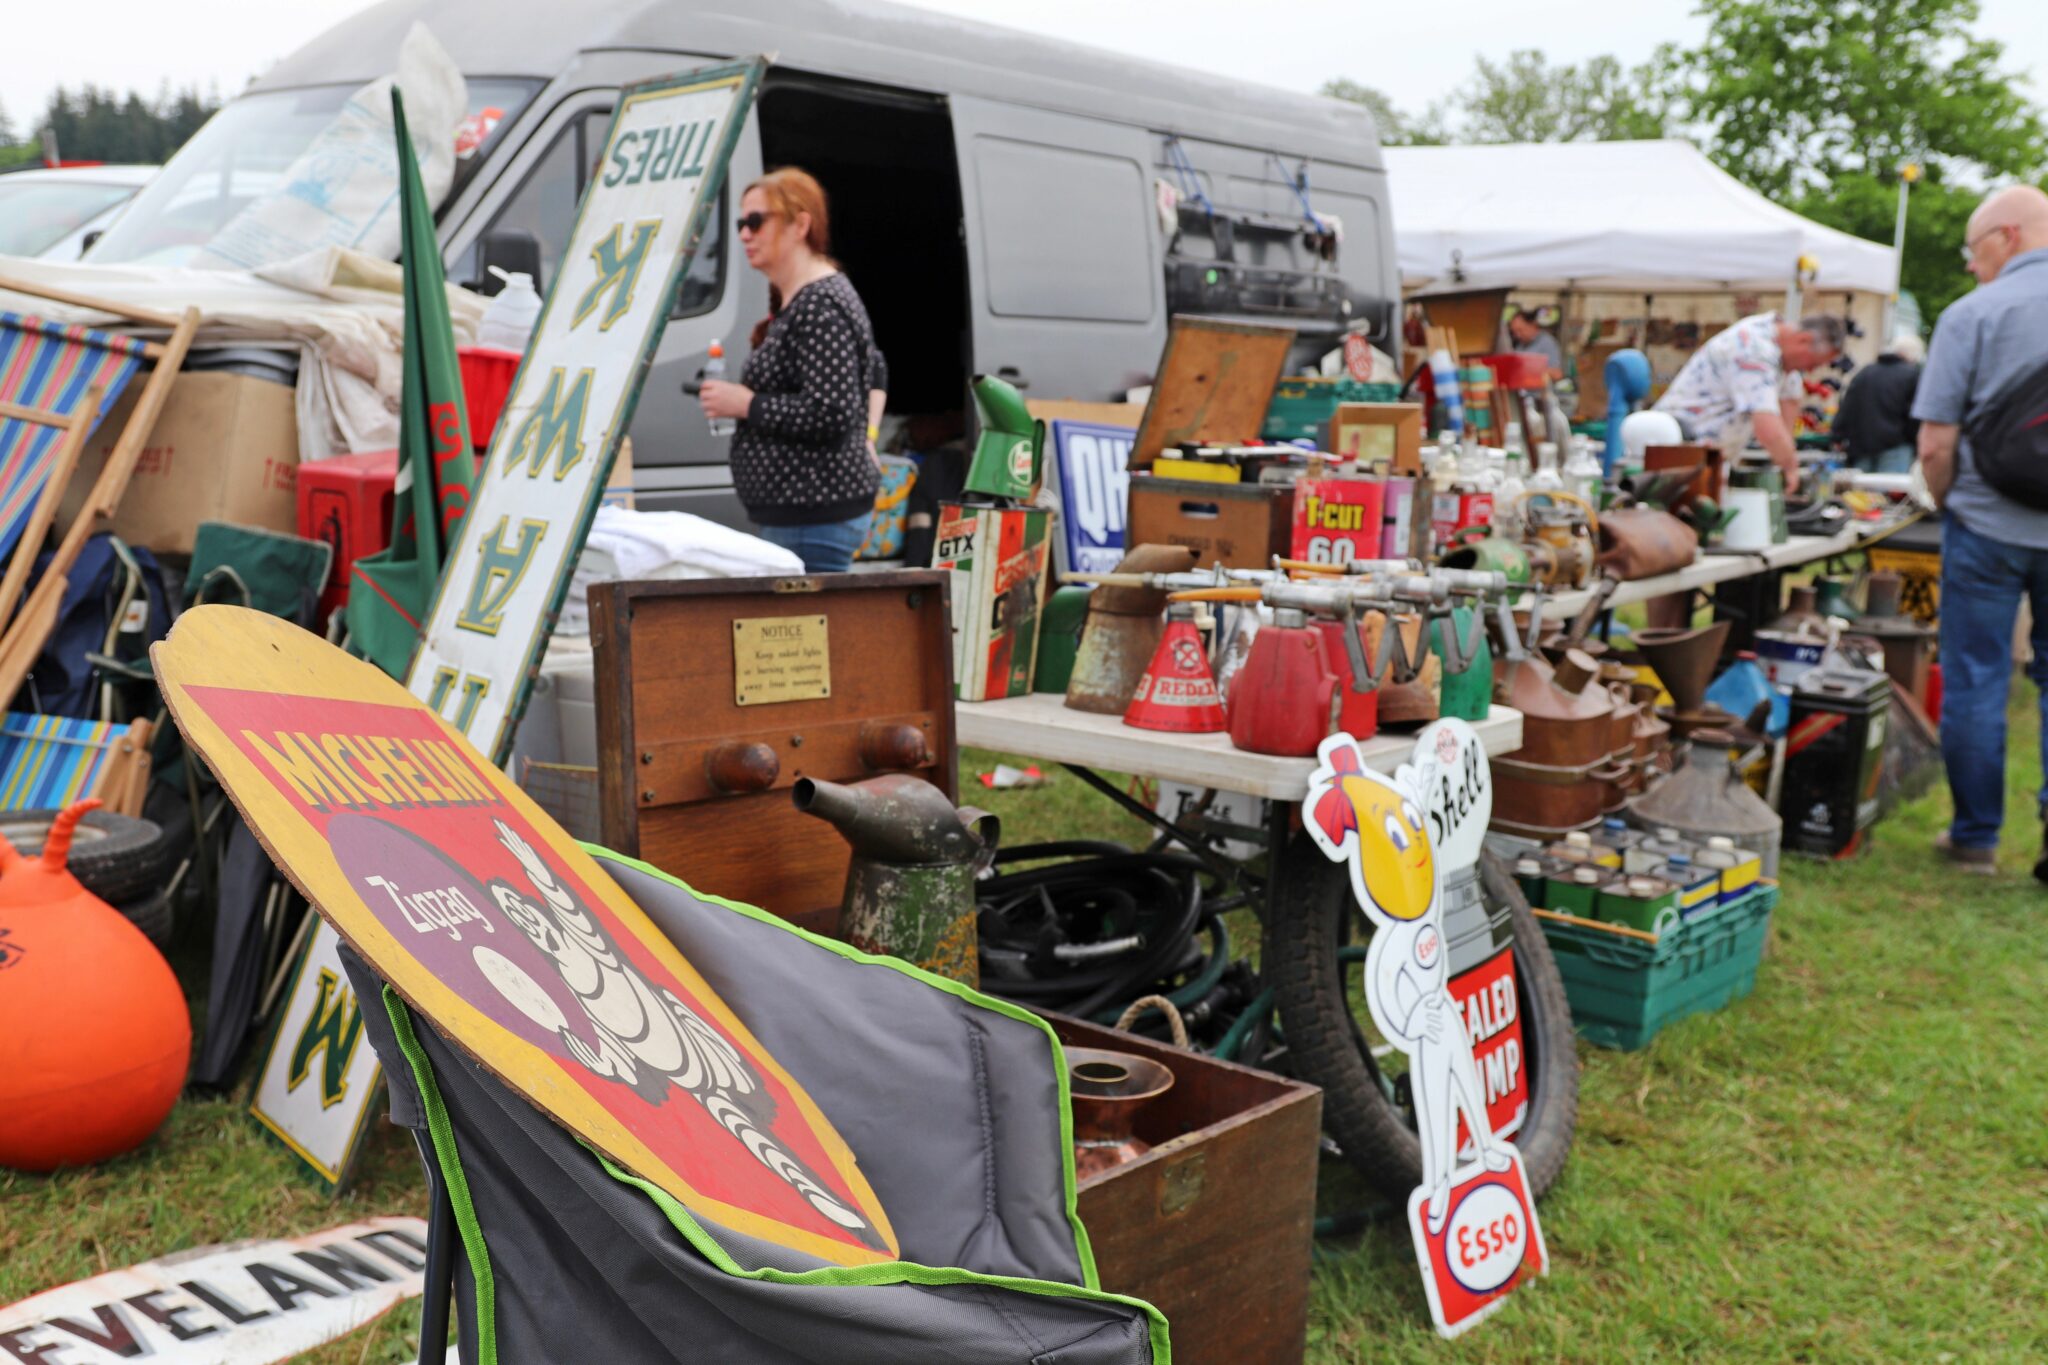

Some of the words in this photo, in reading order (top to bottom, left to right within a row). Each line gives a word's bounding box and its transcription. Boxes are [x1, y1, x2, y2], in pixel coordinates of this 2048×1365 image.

[604, 119, 717, 188] TIRES
[1306, 496, 1364, 530] T-CUT
[939, 533, 974, 558] GTX
[1308, 535, 1356, 564] 60
[761, 624, 803, 638] NOTICE
[240, 730, 502, 810] MICHELIN
[364, 875, 495, 941] Zigzag
[1456, 974, 1517, 1048] ALED
